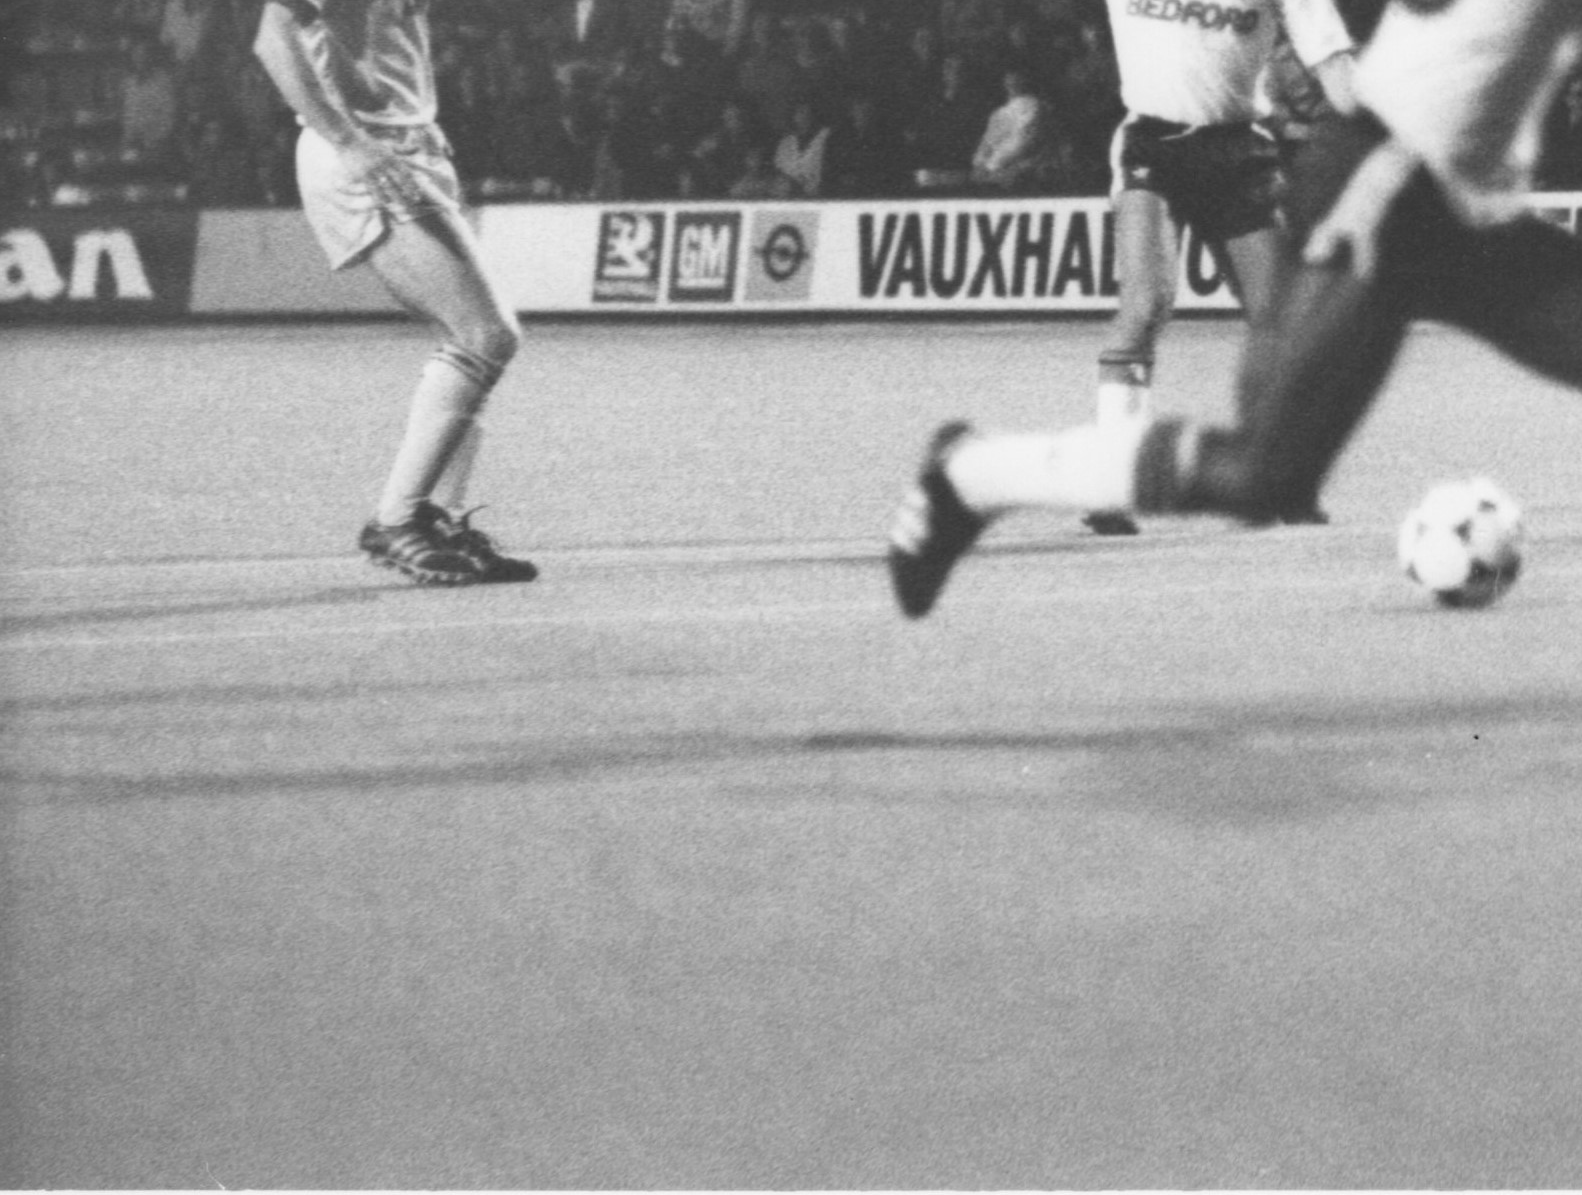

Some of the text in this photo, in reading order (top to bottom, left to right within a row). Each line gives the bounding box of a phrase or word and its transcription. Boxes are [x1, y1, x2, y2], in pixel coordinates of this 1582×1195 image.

[0, 227, 154, 302] an
[679, 223, 732, 280] GM
[857, 211, 1120, 299] VAUXHAL
